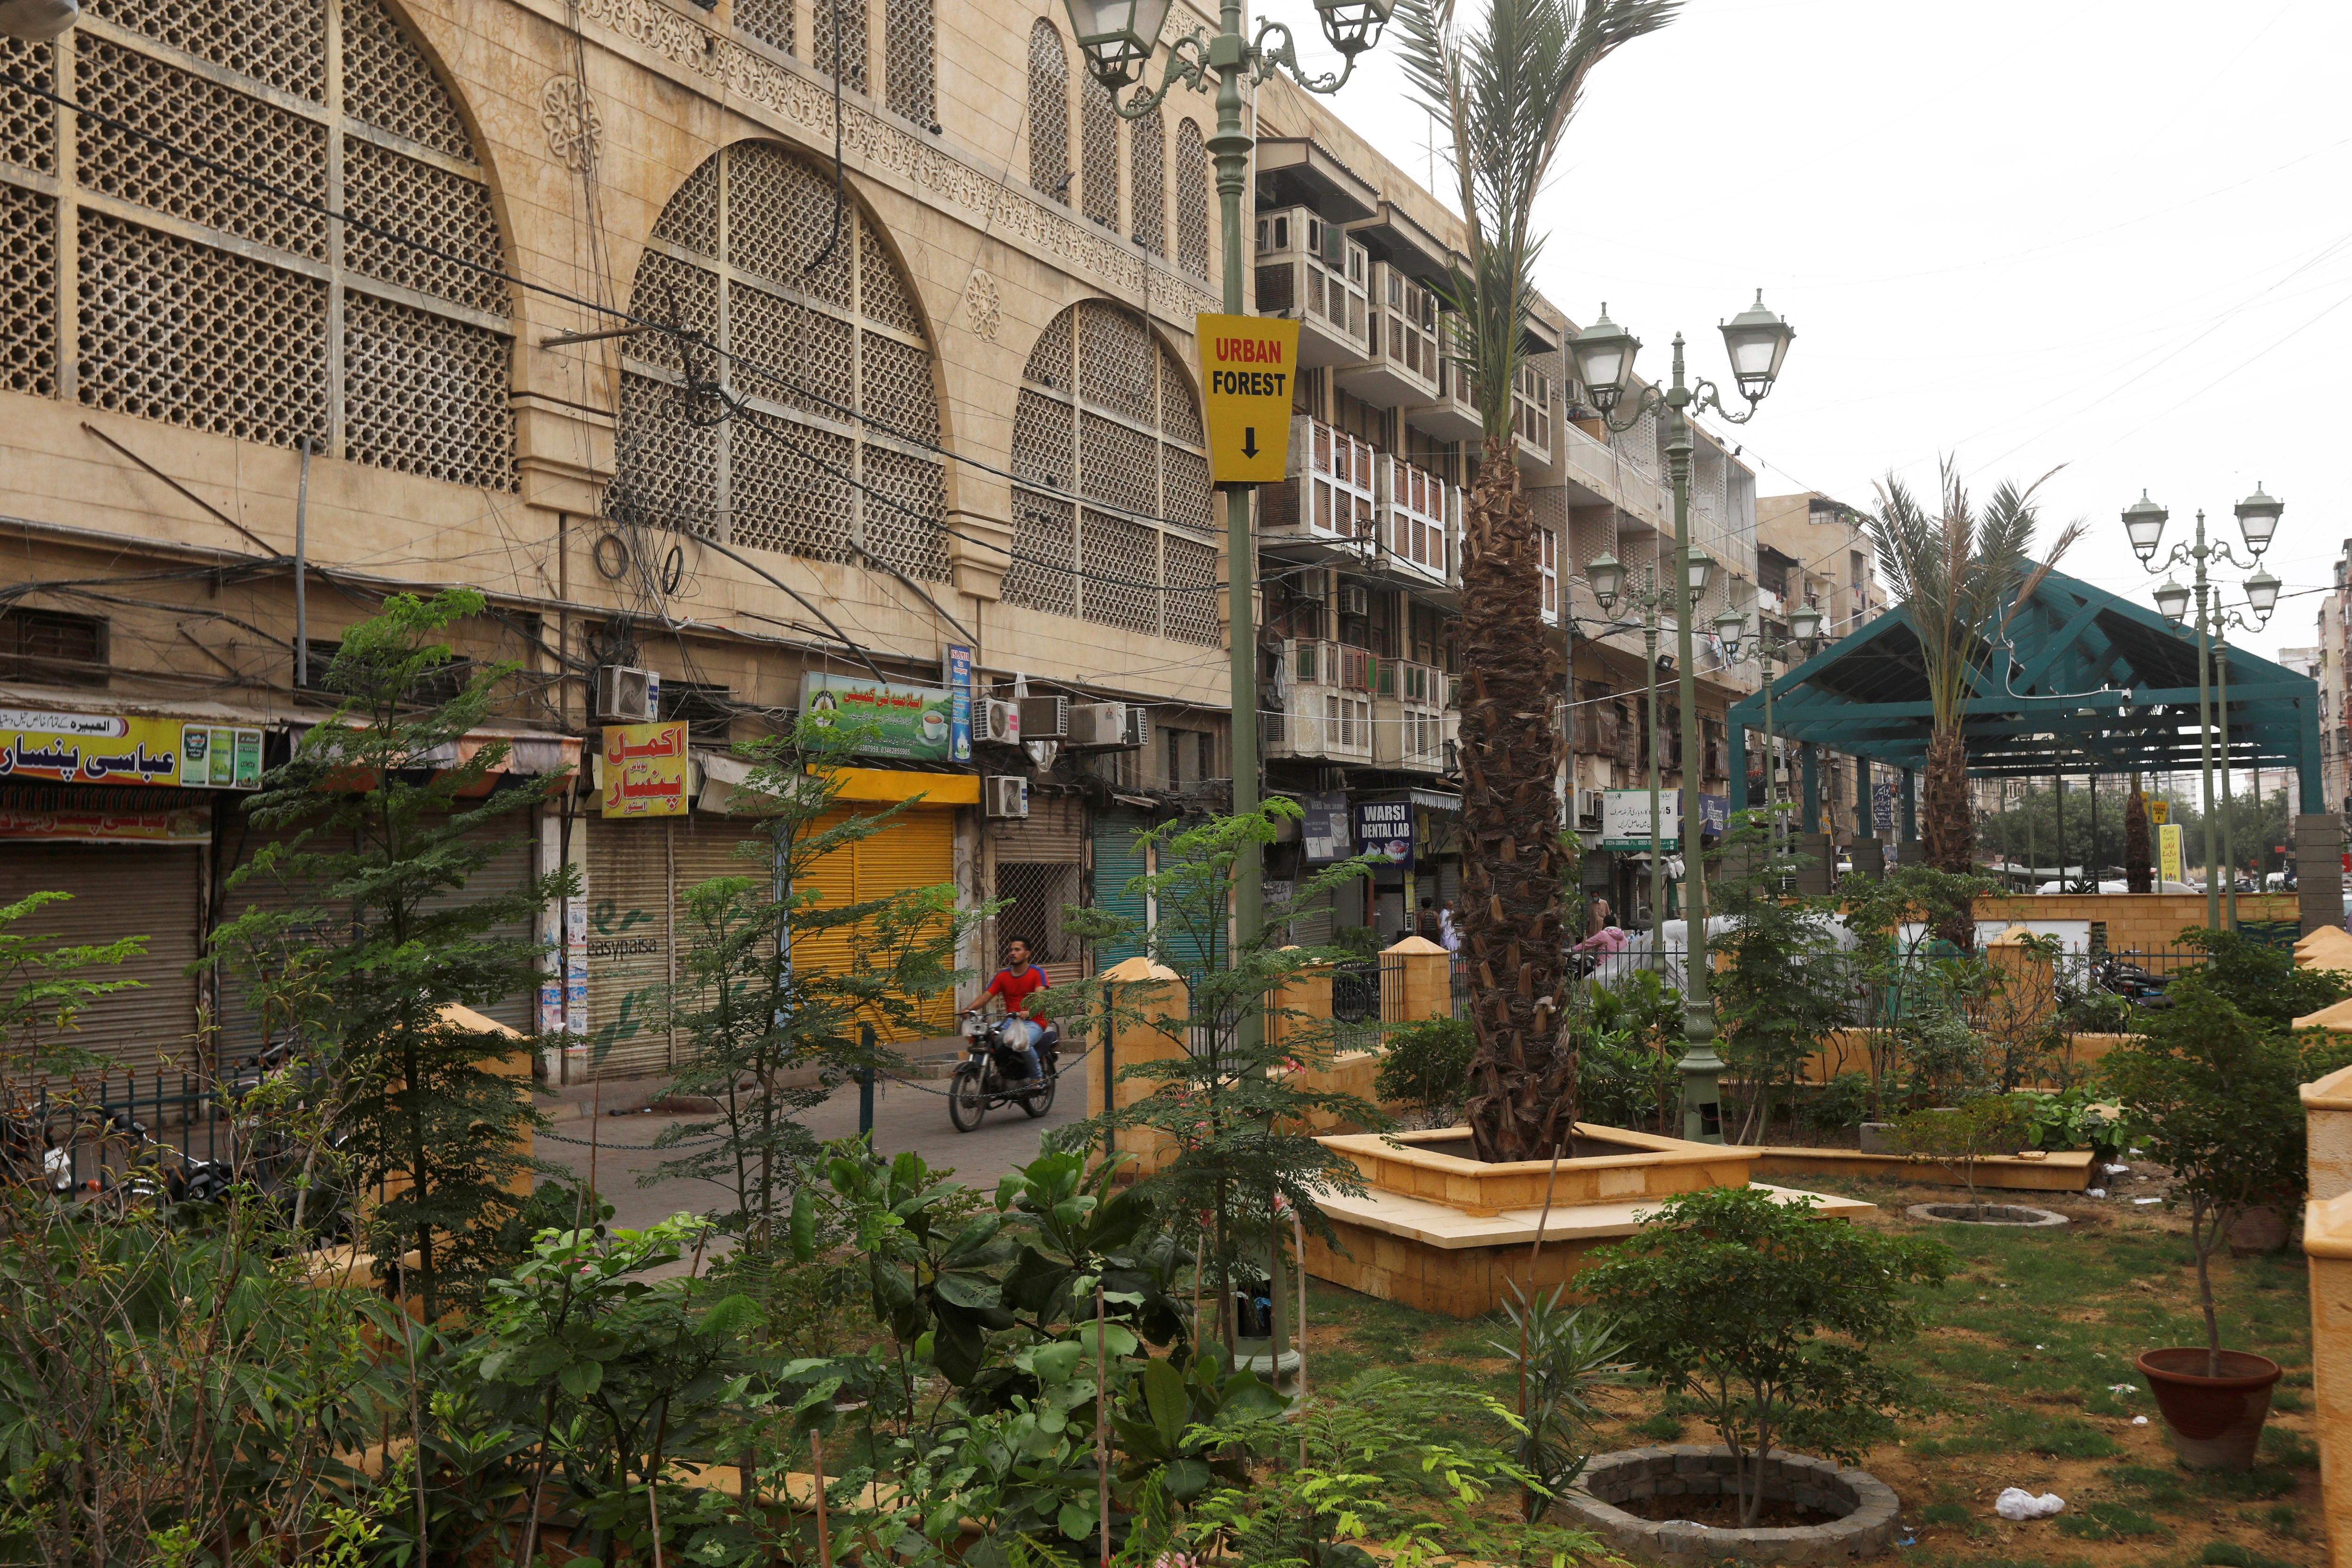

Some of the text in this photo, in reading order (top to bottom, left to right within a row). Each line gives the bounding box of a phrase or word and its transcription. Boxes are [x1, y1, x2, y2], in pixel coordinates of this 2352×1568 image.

[1216, 337, 1281, 364] URBAN
[1213, 370, 1286, 397] FOREST
[951, 649, 970, 661] ISLAMIA
[953, 666, 968, 676] Company
[814, 692, 834, 702] ISLMIA
[842, 685, 876, 707] کمپنی
[607, 726, 683, 766] اکمل
[881, 746, 911, 756] 03462855905
[0, 733, 175, 784] عباسی پنسار
[606, 767, 682, 811] پنسار
[1310, 797, 1322, 809] WARSI
[1364, 805, 1405, 821] WARSI
[1362, 823, 1392, 838] DENTAL
[1393, 822, 1410, 837] LAB
[587, 935, 657, 962] easypaisa
